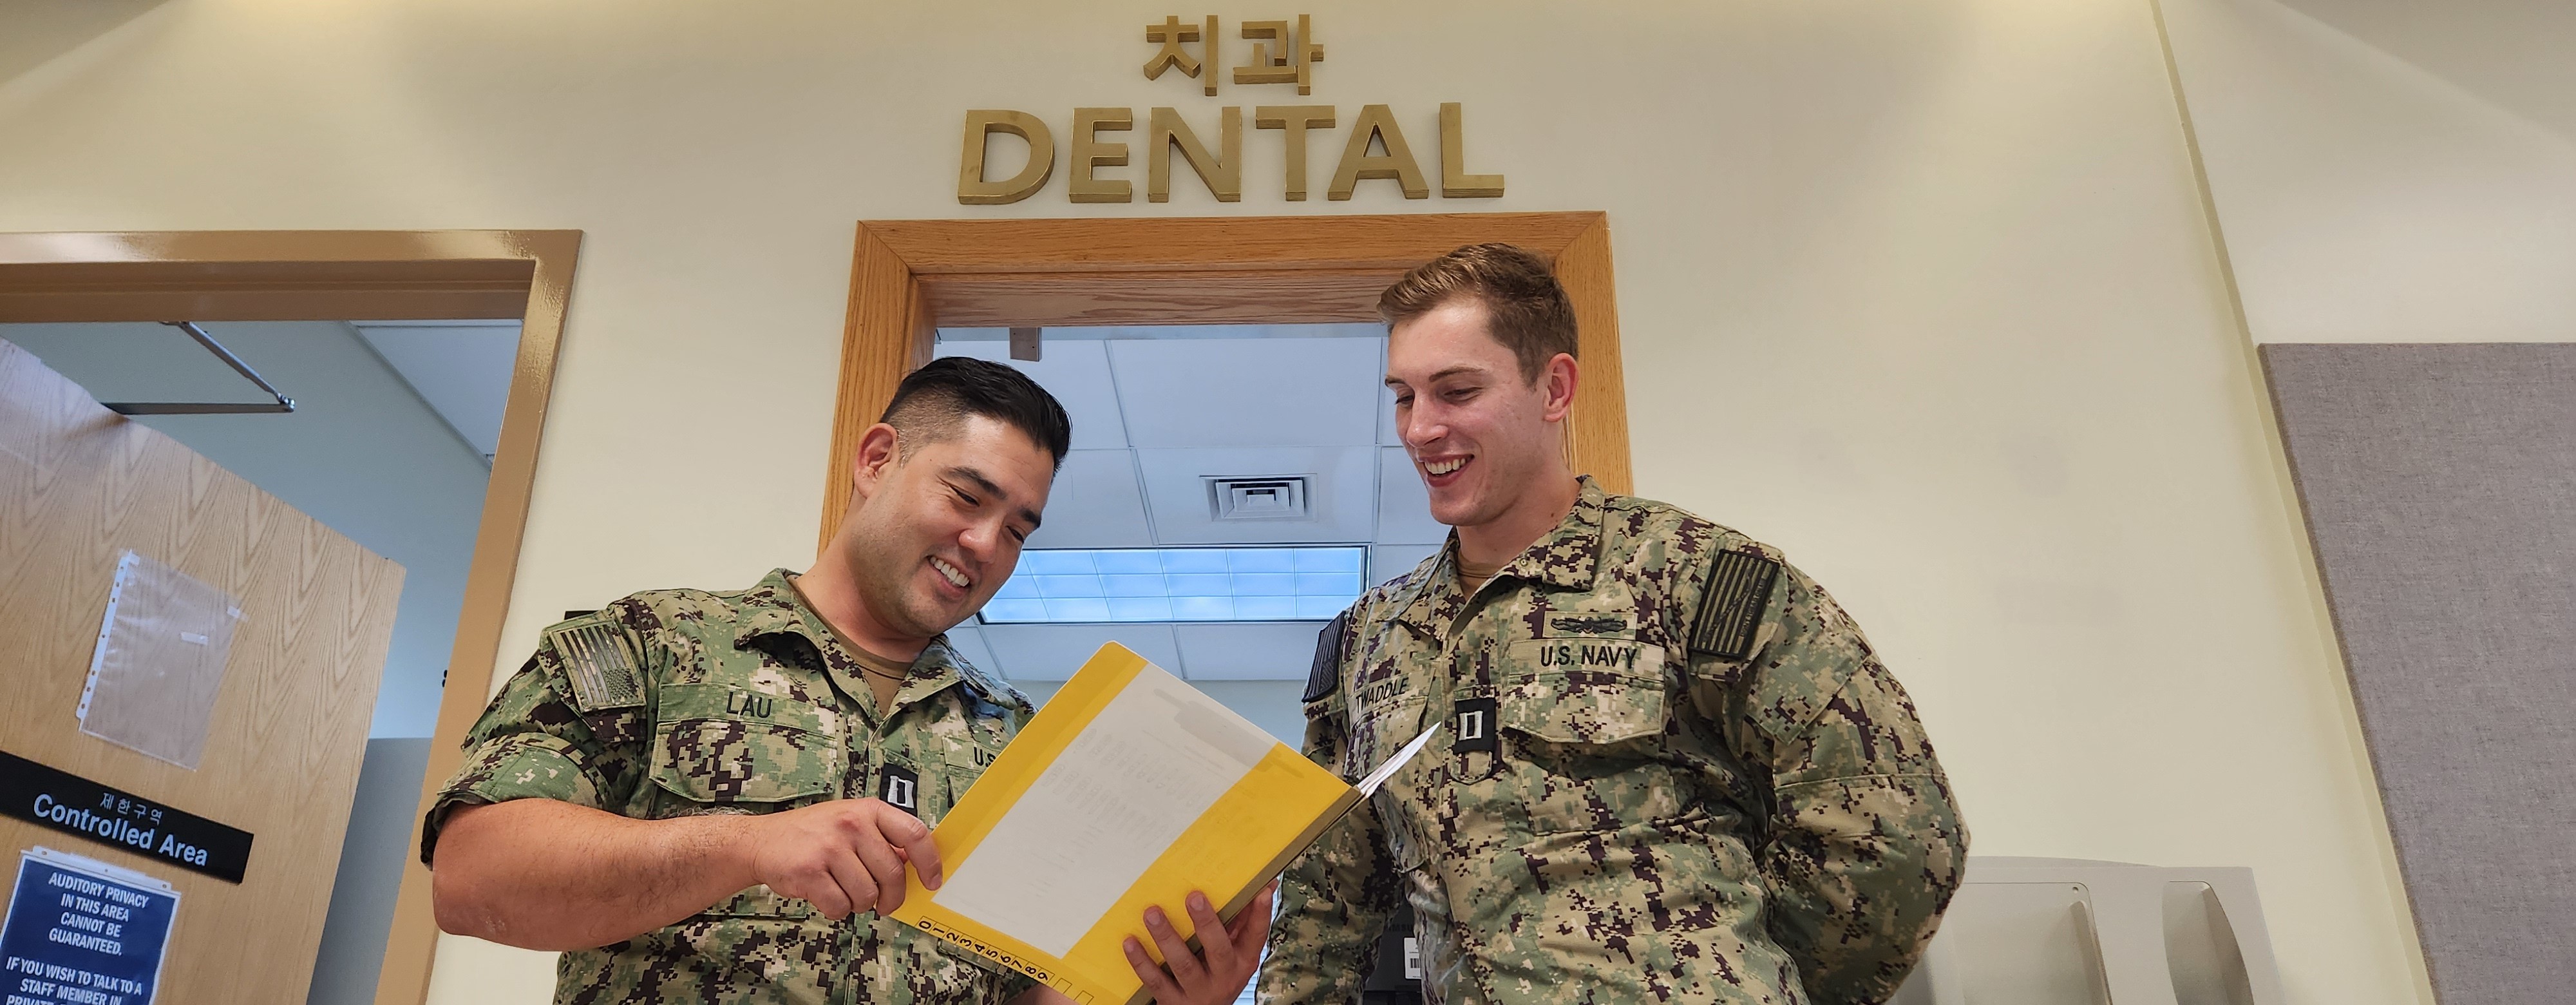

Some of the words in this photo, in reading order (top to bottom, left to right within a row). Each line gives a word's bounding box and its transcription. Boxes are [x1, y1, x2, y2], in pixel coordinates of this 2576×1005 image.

[1143, 14, 1325, 96] 치과
[958, 102, 1505, 205] DENTAL
[1540, 645, 1575, 667] U.S.
[1580, 645, 1637, 669] NAVY
[726, 691, 772, 718] LAU
[1356, 677, 1409, 714] TWADDLE
[100, 792, 163, 826] 제한구역
[33, 794, 155, 850] Controlled
[158, 834, 208, 866] Area
[48, 872, 105, 897] AUDITORY
[105, 886, 149, 908] PRIVACY
[61, 893, 75, 908] IN
[75, 896, 101, 915] THIS
[100, 903, 129, 923] AREA
[61, 911, 106, 933] CANNOT
[106, 922, 122, 938] BE
[48, 927, 122, 956] GUARANTEED.
[918, 921, 931, 930] 0
[946, 933, 960, 941] 2
[960, 938, 972, 946] 3
[973, 944, 985, 953] 4
[985, 950, 998, 958] 5
[1010, 960, 1022, 968] 7
[1025, 966, 1036, 975] 8
[1037, 972, 1048, 981] 9
[6, 956, 21, 970] IF
[20, 958, 44, 976] YOU
[46, 964, 75, 983] WISH
[77, 970, 91, 986] TO
[93, 973, 119, 991] TALK
[120, 979, 133, 993] TO
[133, 982, 142, 995] A
[20, 978, 56, 997] STAFF
[56, 984, 108, 1005] MEMBER
[109, 995, 122, 1005] IN
